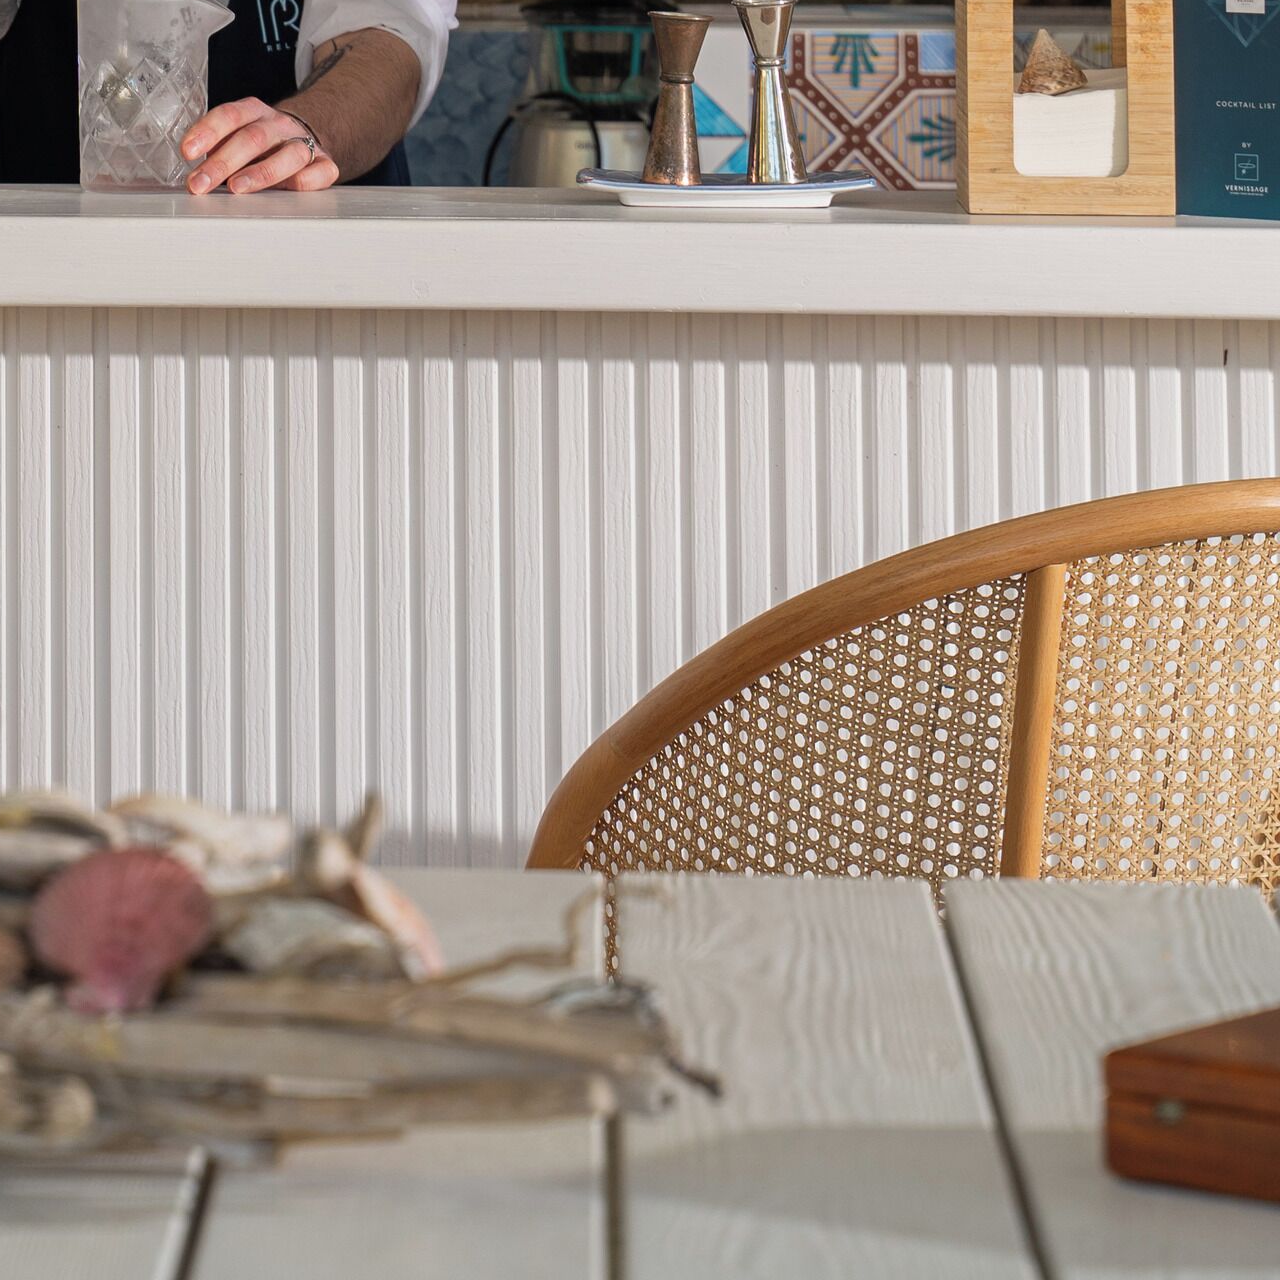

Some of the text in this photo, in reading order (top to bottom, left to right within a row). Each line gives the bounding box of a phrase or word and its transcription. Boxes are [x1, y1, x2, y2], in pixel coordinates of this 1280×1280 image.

[1216, 100, 1277, 110] COCKTAIL LIST
[1225, 184, 1269, 194] VERNISSAGE
